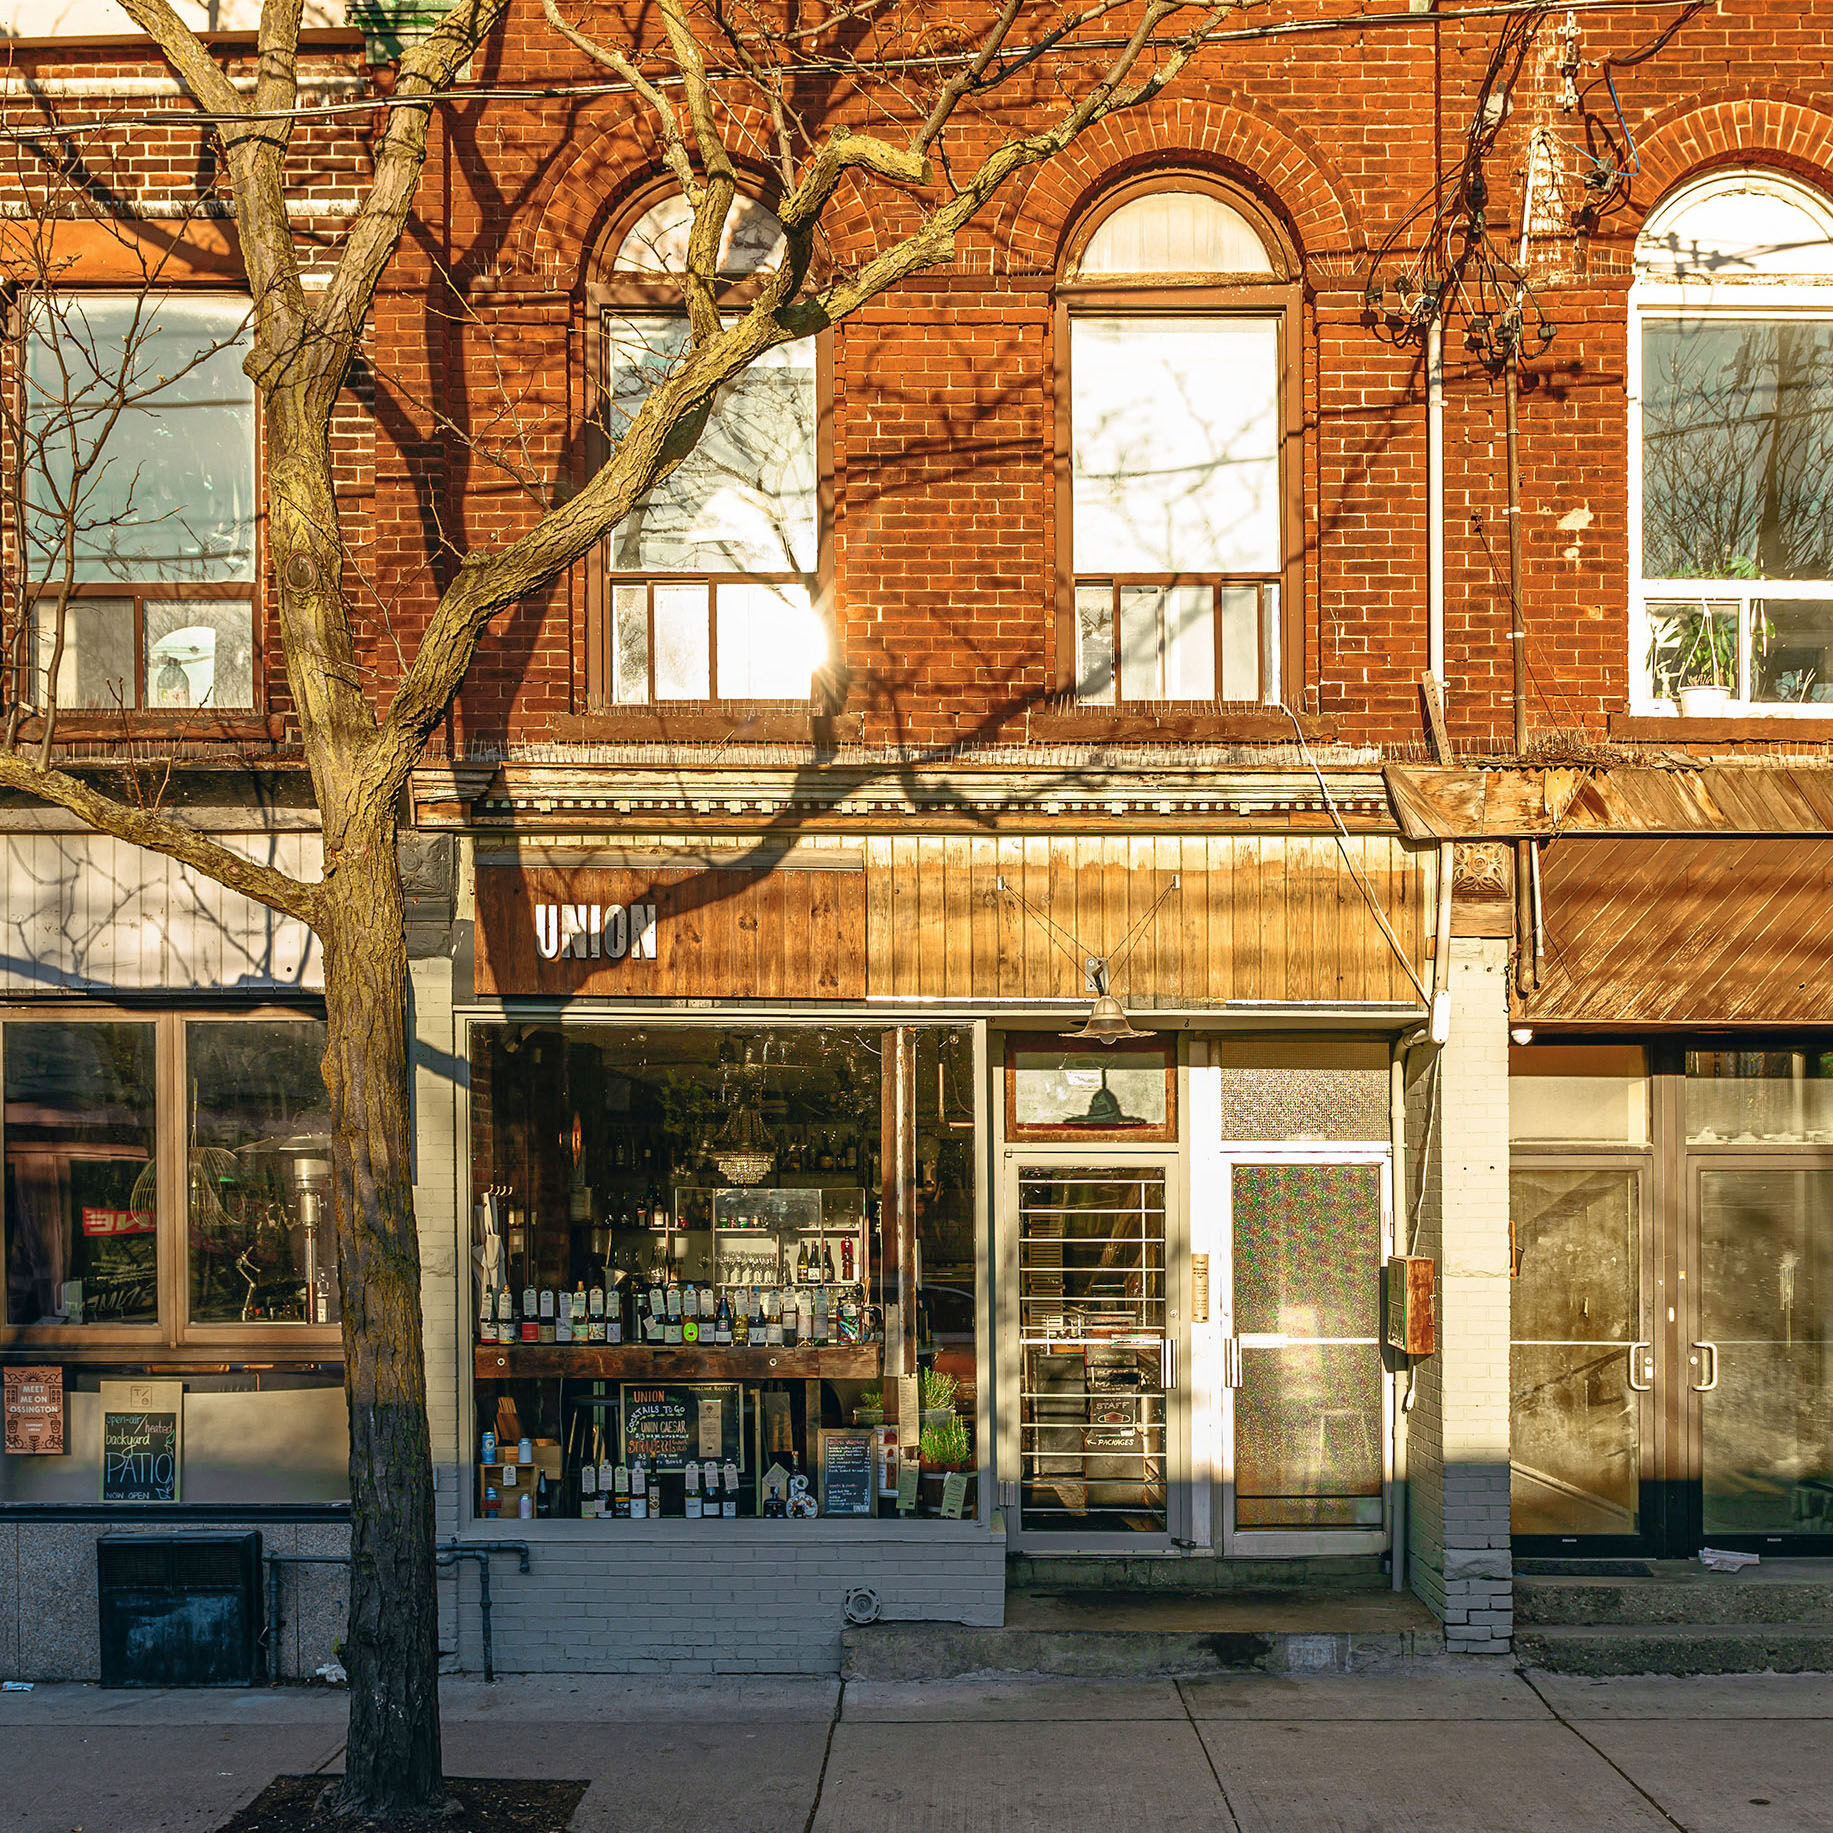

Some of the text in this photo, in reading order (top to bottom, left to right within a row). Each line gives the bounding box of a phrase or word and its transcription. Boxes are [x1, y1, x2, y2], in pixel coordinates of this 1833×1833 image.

[535, 904, 656, 959] UNION
[22, 1385, 45, 1393] MEET
[633, 1390, 665, 1403] UNION
[10, 1405, 59, 1413] OSSINGTON
[626, 1405, 660, 1433] COCKTAILS
[674, 1405, 685, 1413] GO
[145, 1420, 173, 1434] heated
[659, 1420, 687, 1433] CAESAR
[106, 1424, 150, 1456] backyard
[106, 1452, 173, 1484] PATIO
[106, 1491, 150, 1500] NOW OPEN
